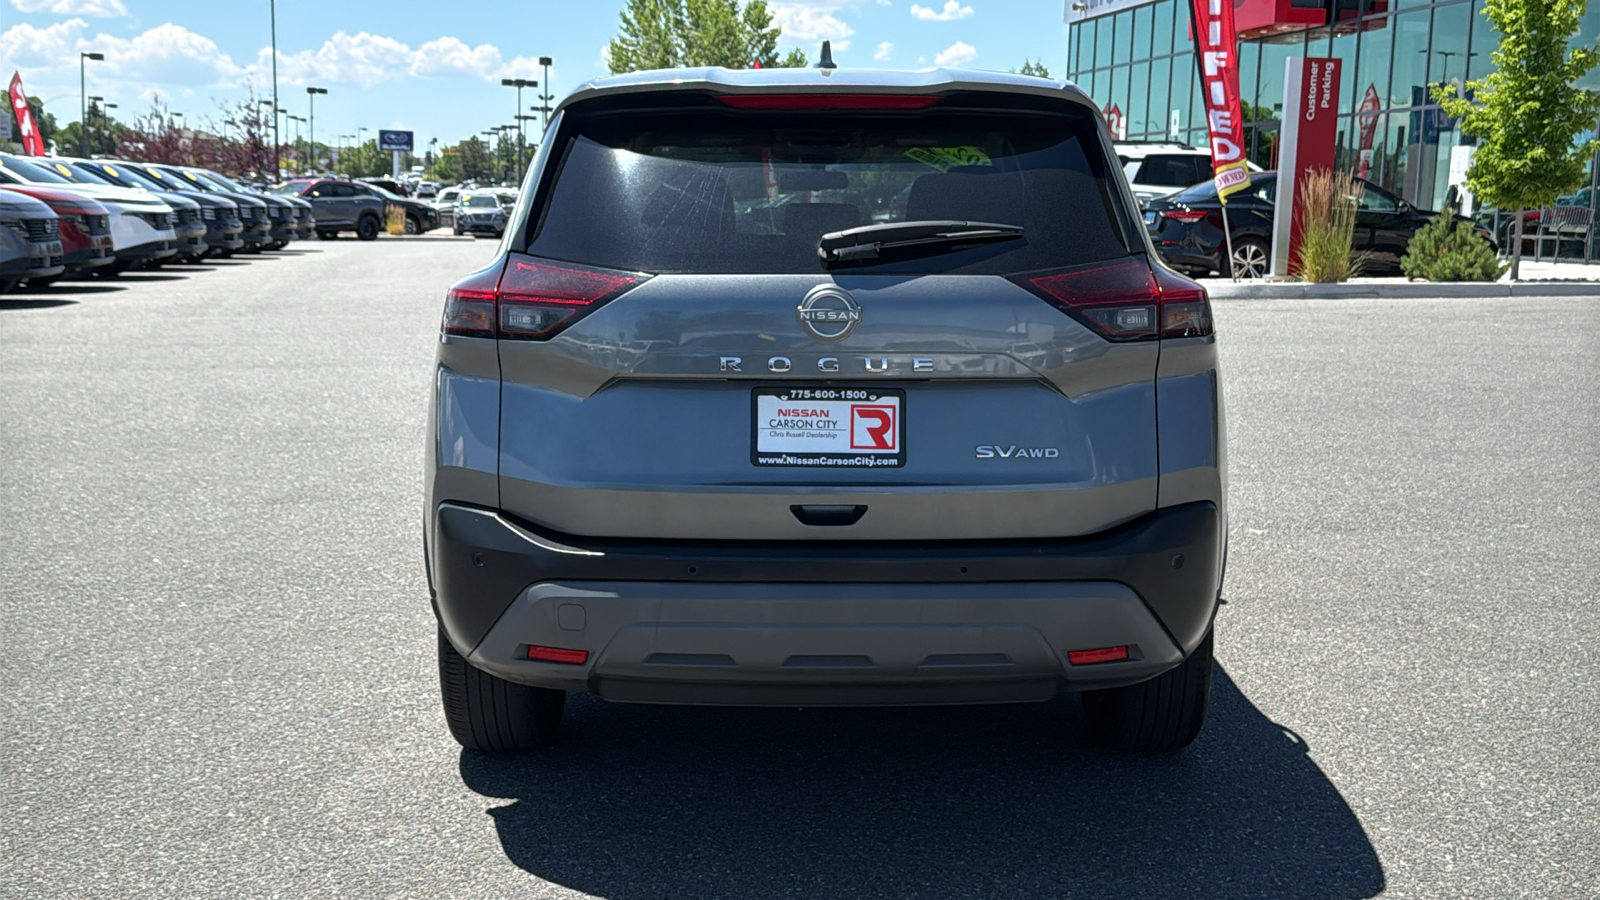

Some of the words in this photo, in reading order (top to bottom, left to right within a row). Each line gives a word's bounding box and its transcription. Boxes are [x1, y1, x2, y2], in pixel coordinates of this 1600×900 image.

[1321, 62, 1335, 108] Parking
[1306, 61, 1319, 121] Customer
[800, 311, 859, 320] NISSAN
[719, 356, 934, 373] ROGUE
[790, 390, 867, 399] 775-600-1500
[777, 408, 830, 418] NISSAN
[769, 419, 813, 429] CARSON
[816, 419, 838, 429] CITY
[806, 431, 838, 440] Dealership
[975, 445, 1016, 458] SV
[1015, 448, 1059, 458] AWD
[758, 456, 898, 467] www.NissanCarsonCity.com
